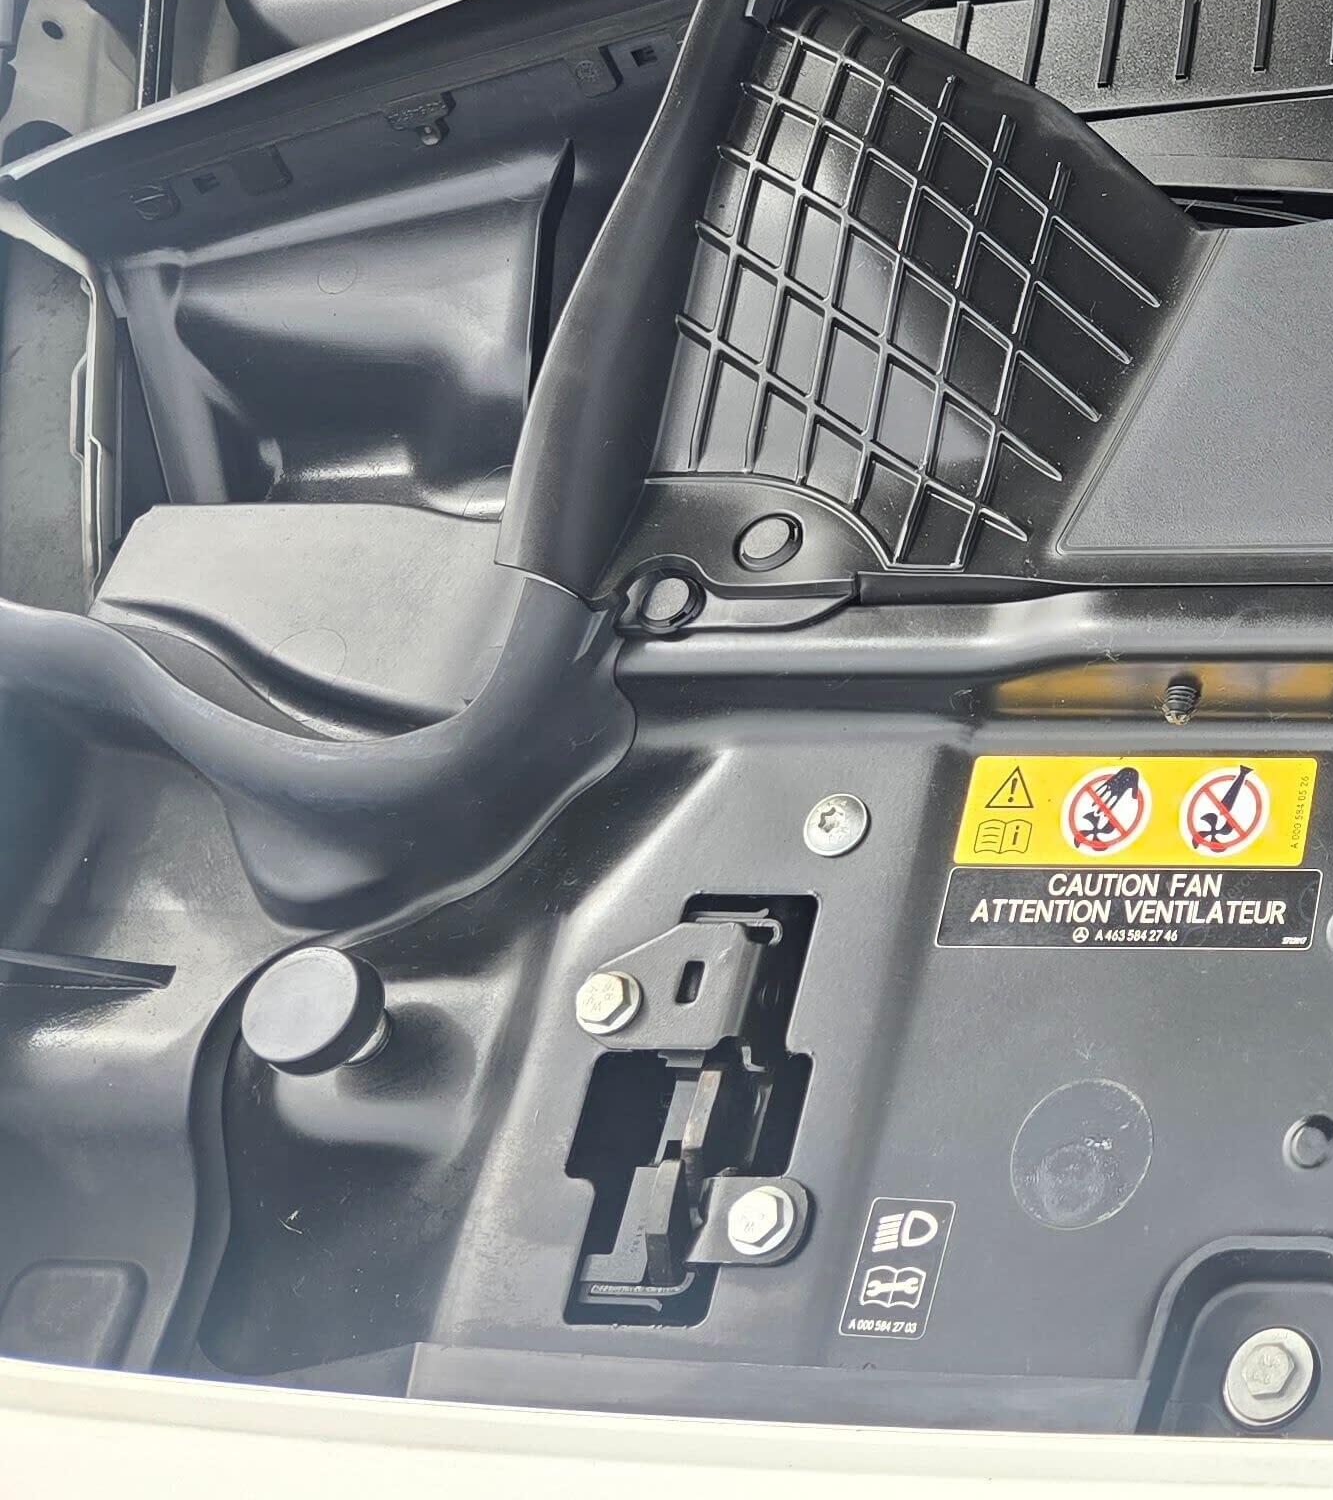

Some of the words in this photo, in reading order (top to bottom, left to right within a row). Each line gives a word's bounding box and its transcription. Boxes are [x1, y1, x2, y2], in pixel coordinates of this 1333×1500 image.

[1048, 873, 1160, 897] CAUTION
[1169, 873, 1223, 898] FAN
[969, 898, 1112, 924] ATTENTION
[1124, 900, 1287, 925] VENTILATEUR
[1095, 930, 1104, 942] A
[1104, 930, 1126, 942] 463
[1126, 930, 1148, 942] 584
[1148, 930, 1163, 942] 27
[1163, 930, 1178, 942] 46
[848, 1319, 856, 1330] A
[857, 1319, 874, 1331] 000
[874, 1320, 892, 1332] 584
[892, 1321, 905, 1333] 27
[904, 1322, 918, 1334] 03
